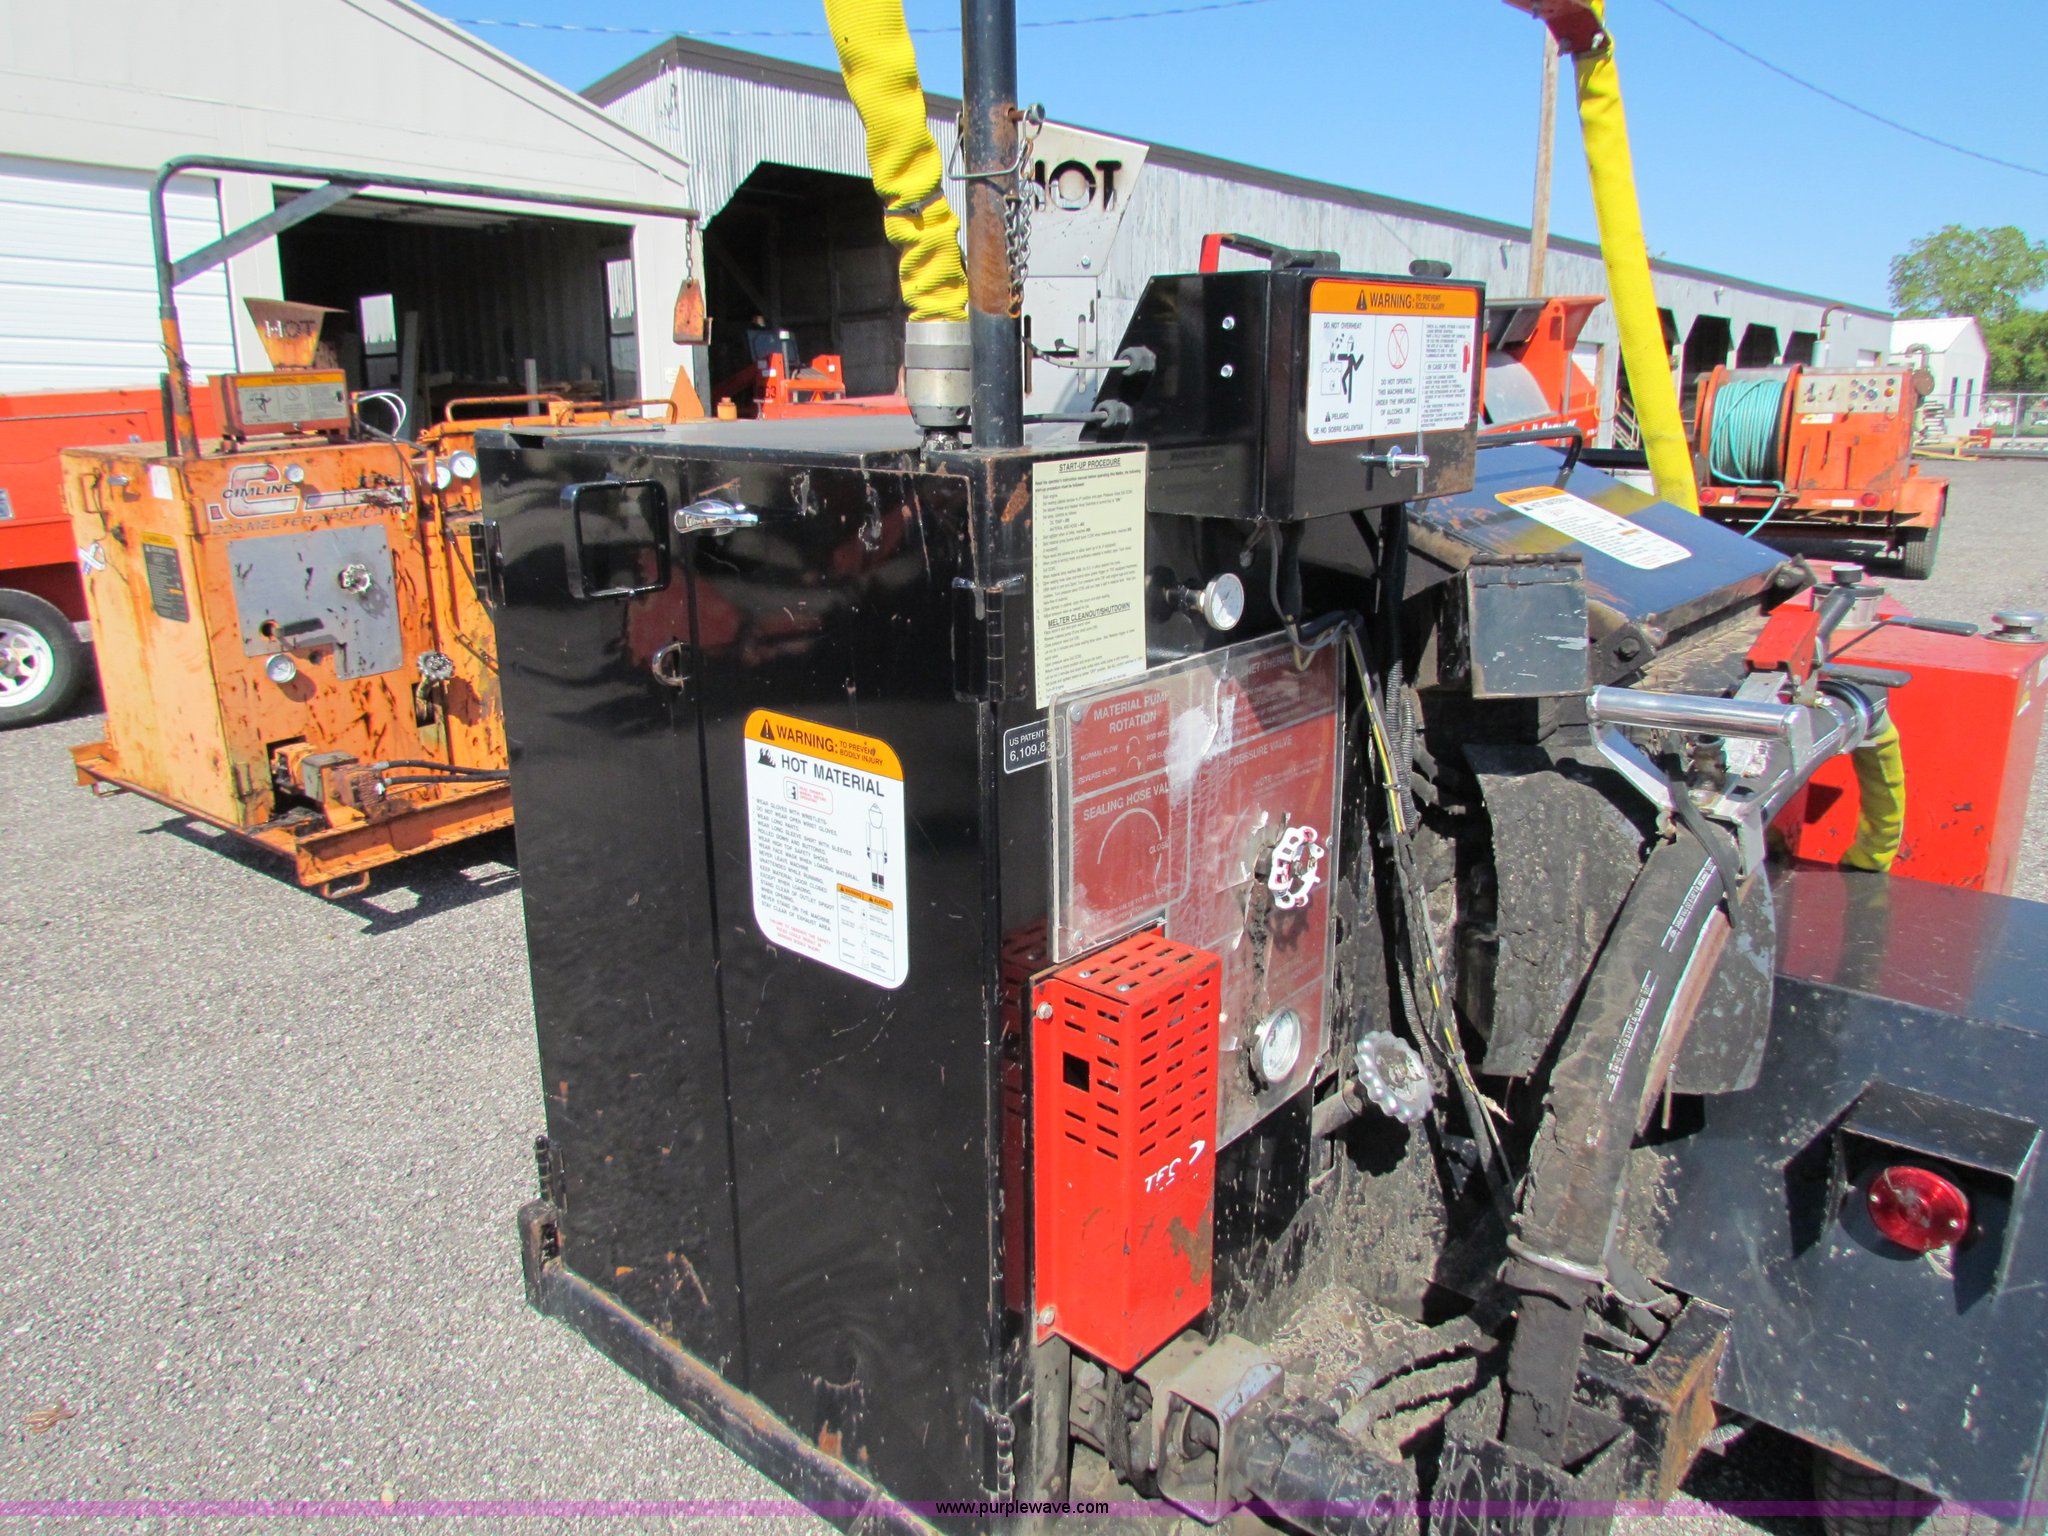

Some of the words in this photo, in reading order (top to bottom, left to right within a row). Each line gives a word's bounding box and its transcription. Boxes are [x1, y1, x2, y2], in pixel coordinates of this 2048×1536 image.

[1370, 293, 1415, 309] WARNING:
[265, 320, 316, 338] HOT
[1059, 461, 1086, 472] START-UP
[1088, 458, 1120, 468] PROCEDURE
[222, 483, 294, 499] CIMLINE
[1048, 616, 1070, 627] MELTER
[1094, 698, 1141, 721] MATERIAL
[1144, 691, 1170, 707] PUMP
[1109, 711, 1156, 734] ROTATION
[776, 725, 838, 754] WARNING:
[1009, 737, 1020, 746] US
[1020, 729, 1045, 743] PATENT
[839, 749, 861, 760] BODILY
[862, 755, 883, 766] INJURY
[1104, 744, 1119, 754] FLOW
[1229, 744, 1268, 767] PRESSURE
[1270, 735, 1293, 750] VALVE
[781, 754, 808, 775] HOT
[813, 763, 885, 797] MATERIAL
[1083, 798, 1124, 821] SEALING
[1127, 787, 1152, 805] HOSE
[1153, 782, 1169, 796] VAL
